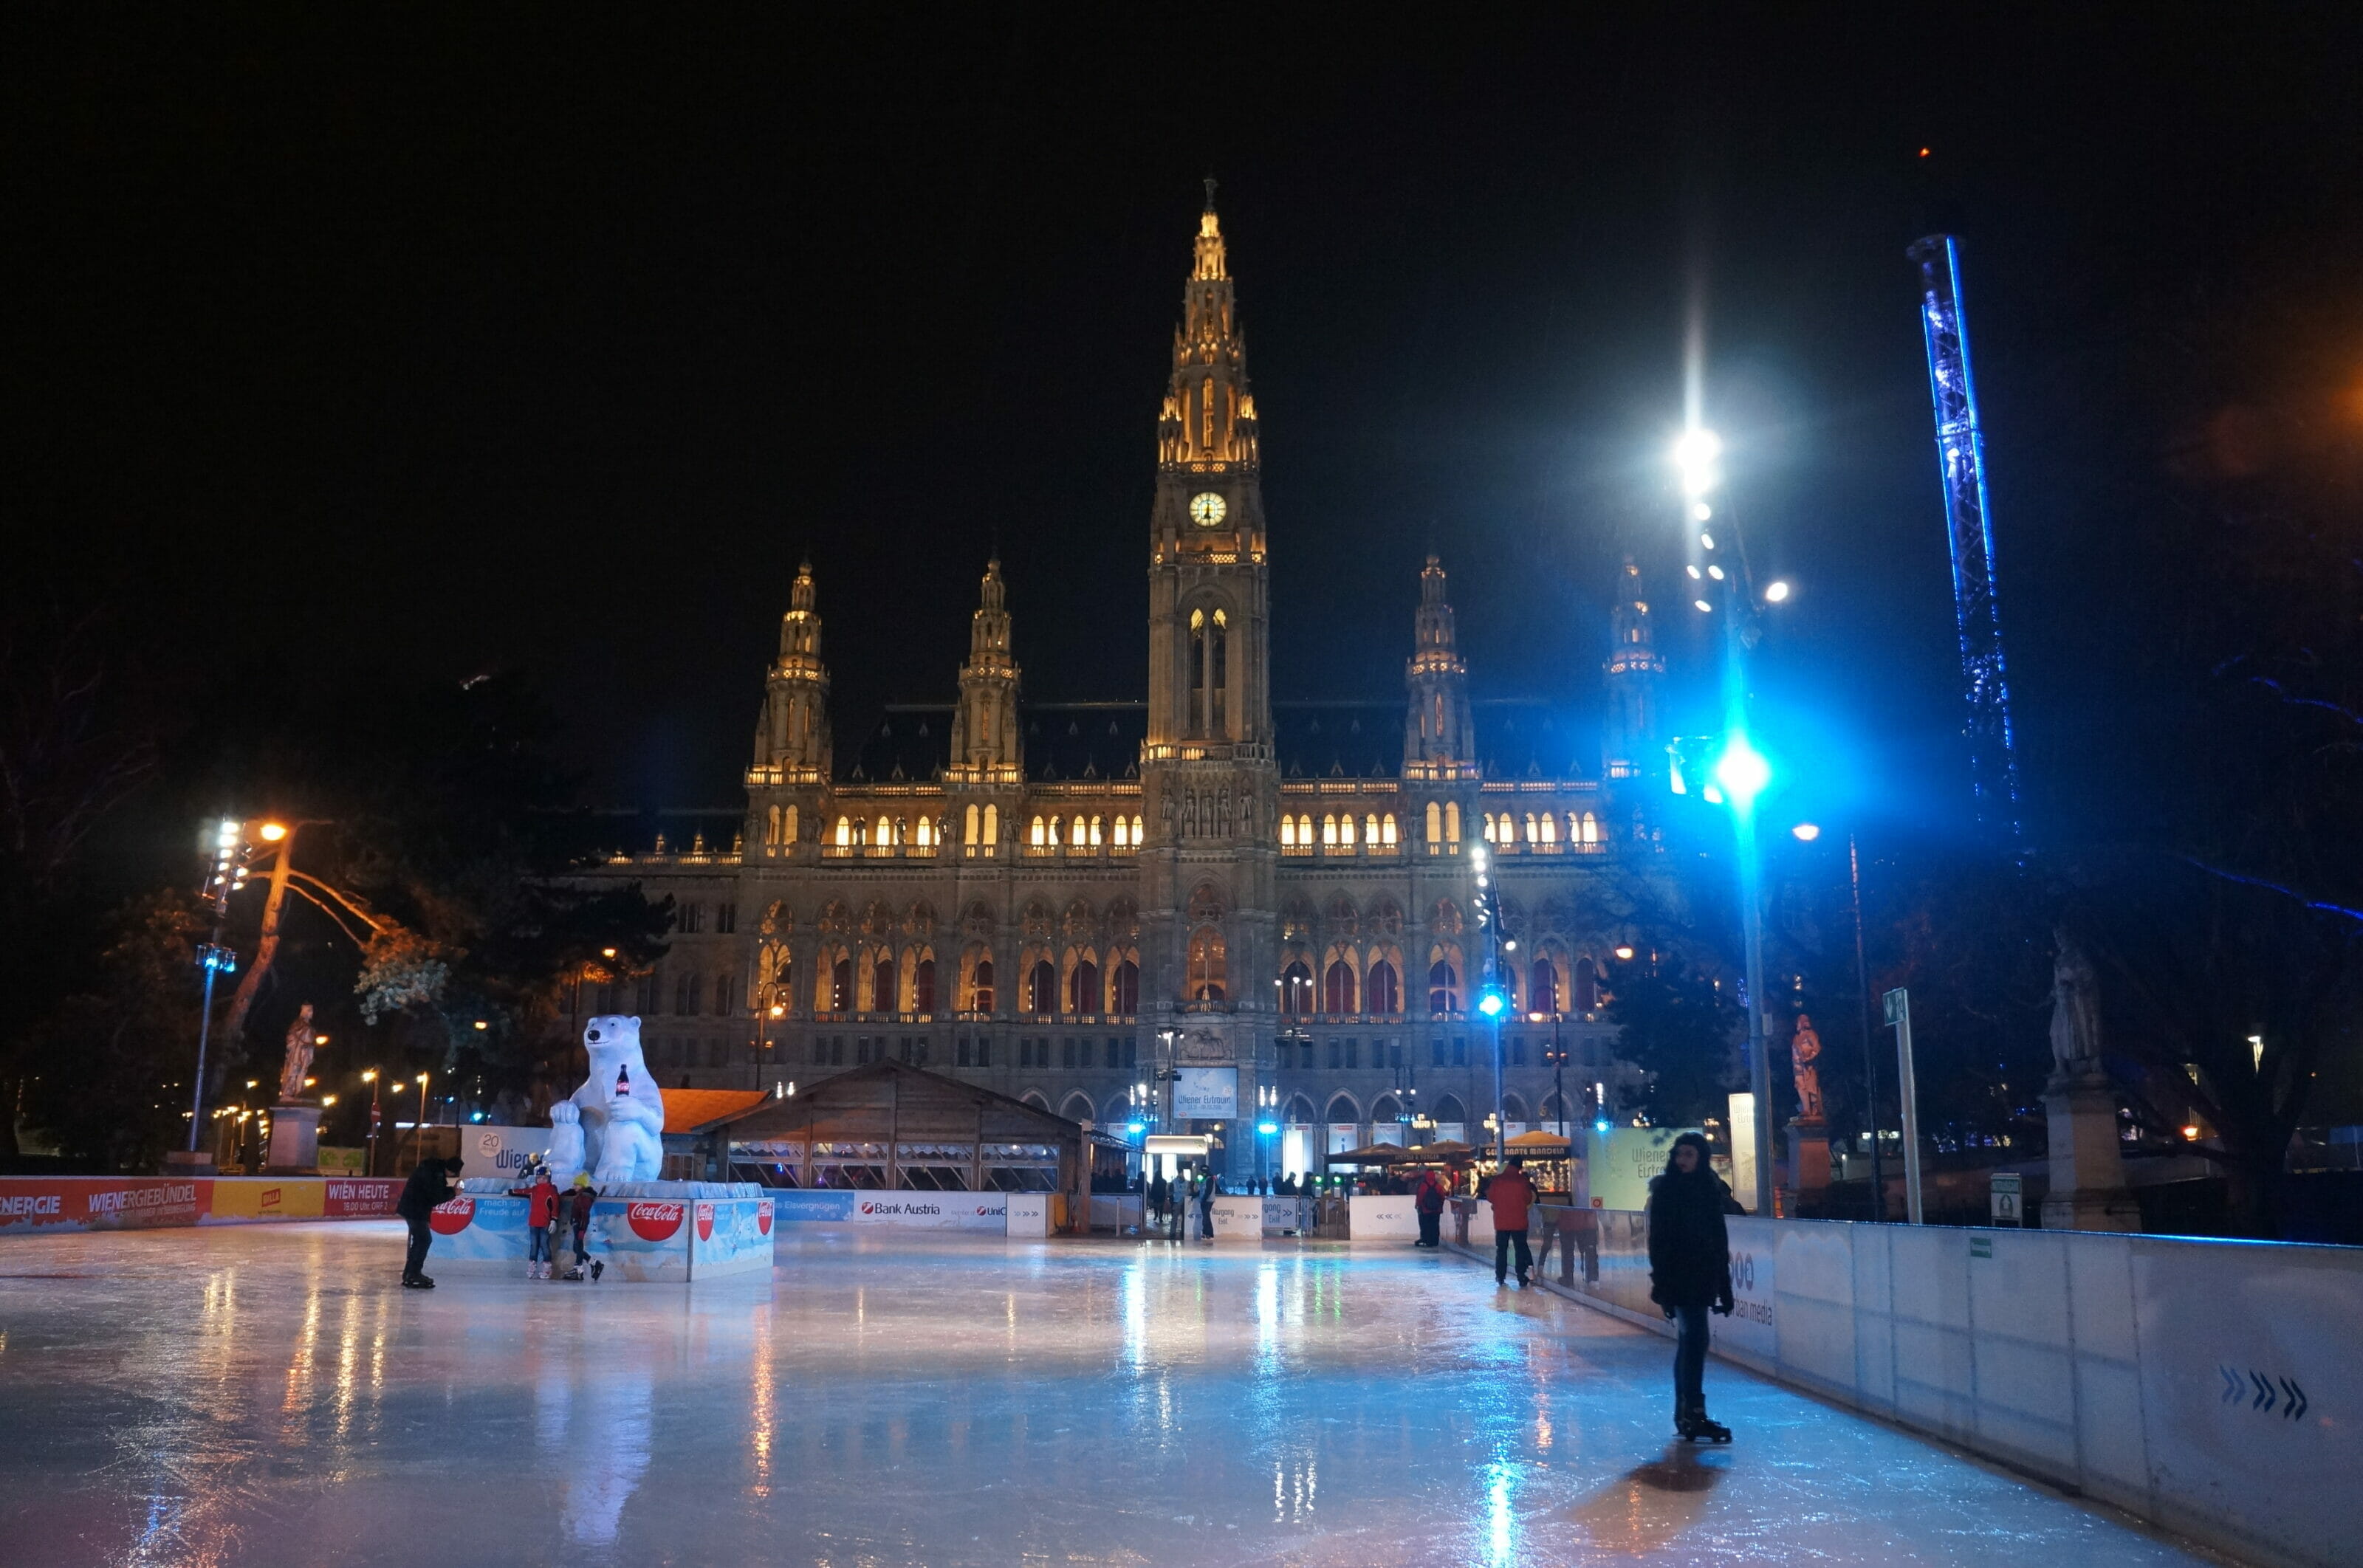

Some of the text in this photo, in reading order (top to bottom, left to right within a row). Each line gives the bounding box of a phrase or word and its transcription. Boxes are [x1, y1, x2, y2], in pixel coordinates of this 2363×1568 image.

[483, 1134, 499, 1147] 20
[89, 1183, 196, 1212] WIENERGIEBÜNDEL
[358, 1184, 389, 1199] HEUTE
[0, 1196, 61, 1215] NERGIE
[479, 1207, 510, 1216] Freude
[631, 1203, 682, 1221] Coca-Cola
[875, 1203, 902, 1214] Bank
[904, 1203, 940, 1214] Austria
[1212, 1208, 1235, 1217] Ausgang
[1269, 1214, 1280, 1223] Exit
[1749, 1299, 1772, 1326] media
